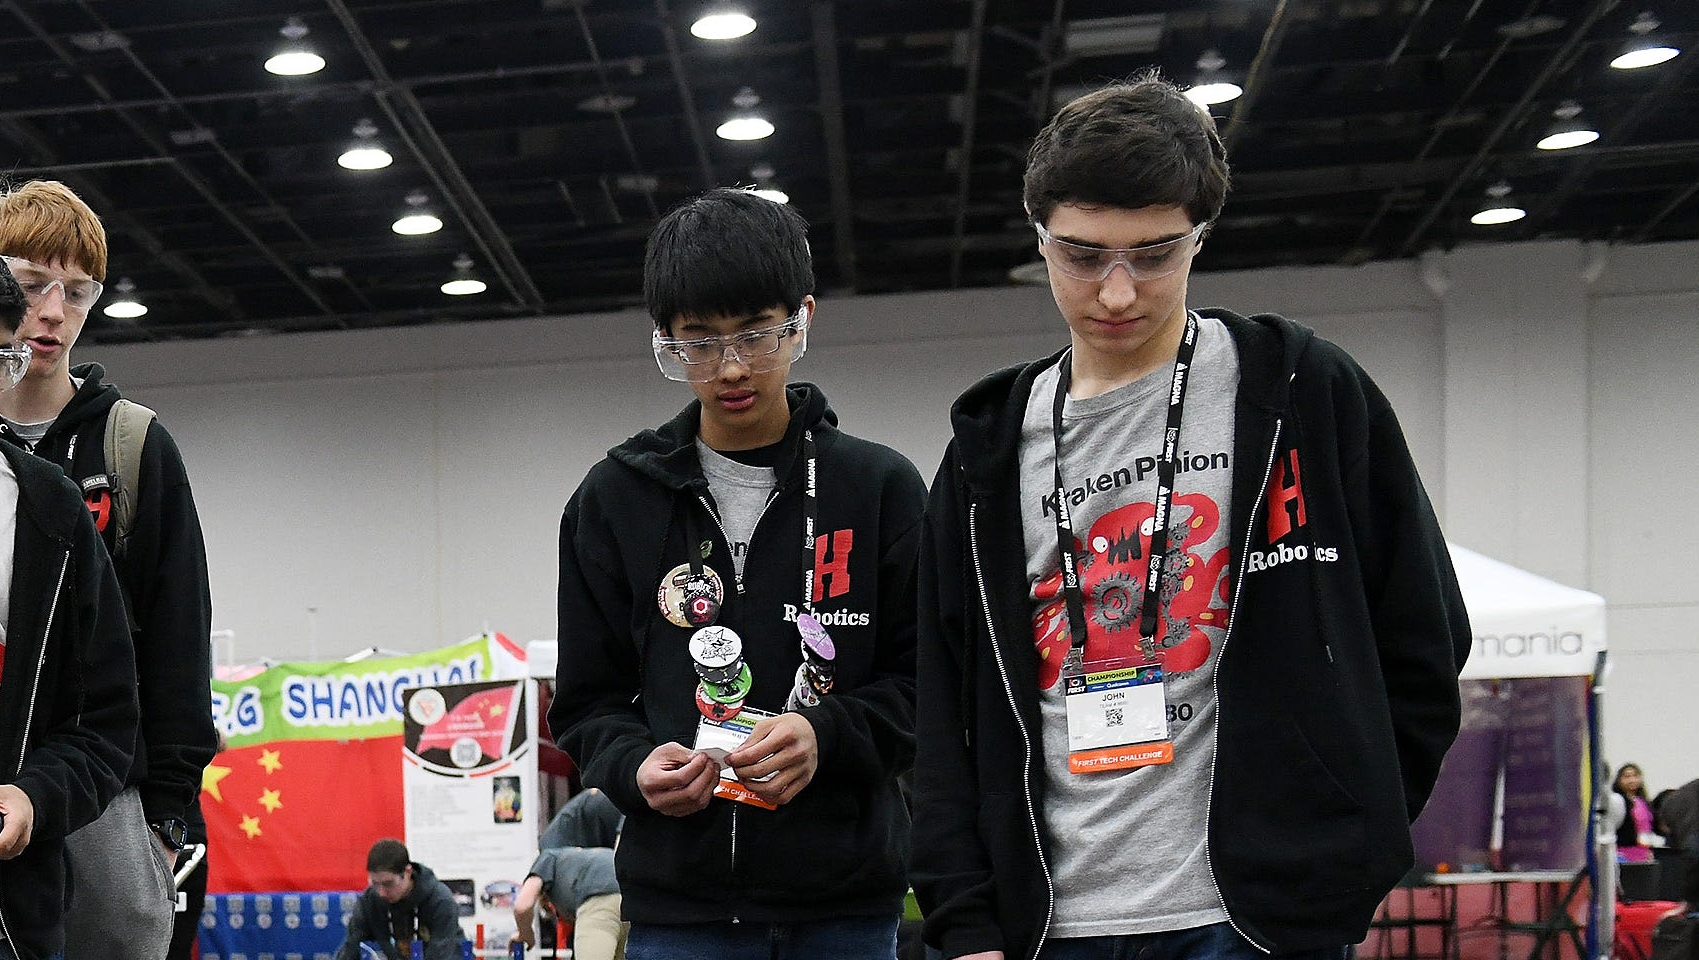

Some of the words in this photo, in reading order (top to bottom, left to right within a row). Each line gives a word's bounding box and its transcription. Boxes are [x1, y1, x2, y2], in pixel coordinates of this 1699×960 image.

[1170, 370, 1183, 405] MAGNA
[808, 458, 816, 489] MAGNA
[1267, 448, 1307, 544] H
[1155, 495, 1168, 532] MAGNA
[812, 528, 853, 603] H
[1247, 541, 1339, 573] Roboics
[805, 570, 814, 601] MAGNA
[782, 602, 870, 627] Rbotics
[1067, 685, 1087, 694] FIRST
[1087, 670, 1136, 682] CHAMPIONSHIP
[1102, 692, 1125, 702] JOHN
[1077, 759, 1098, 767] FIRST
[1119, 751, 1163, 762] CHALLENGE
